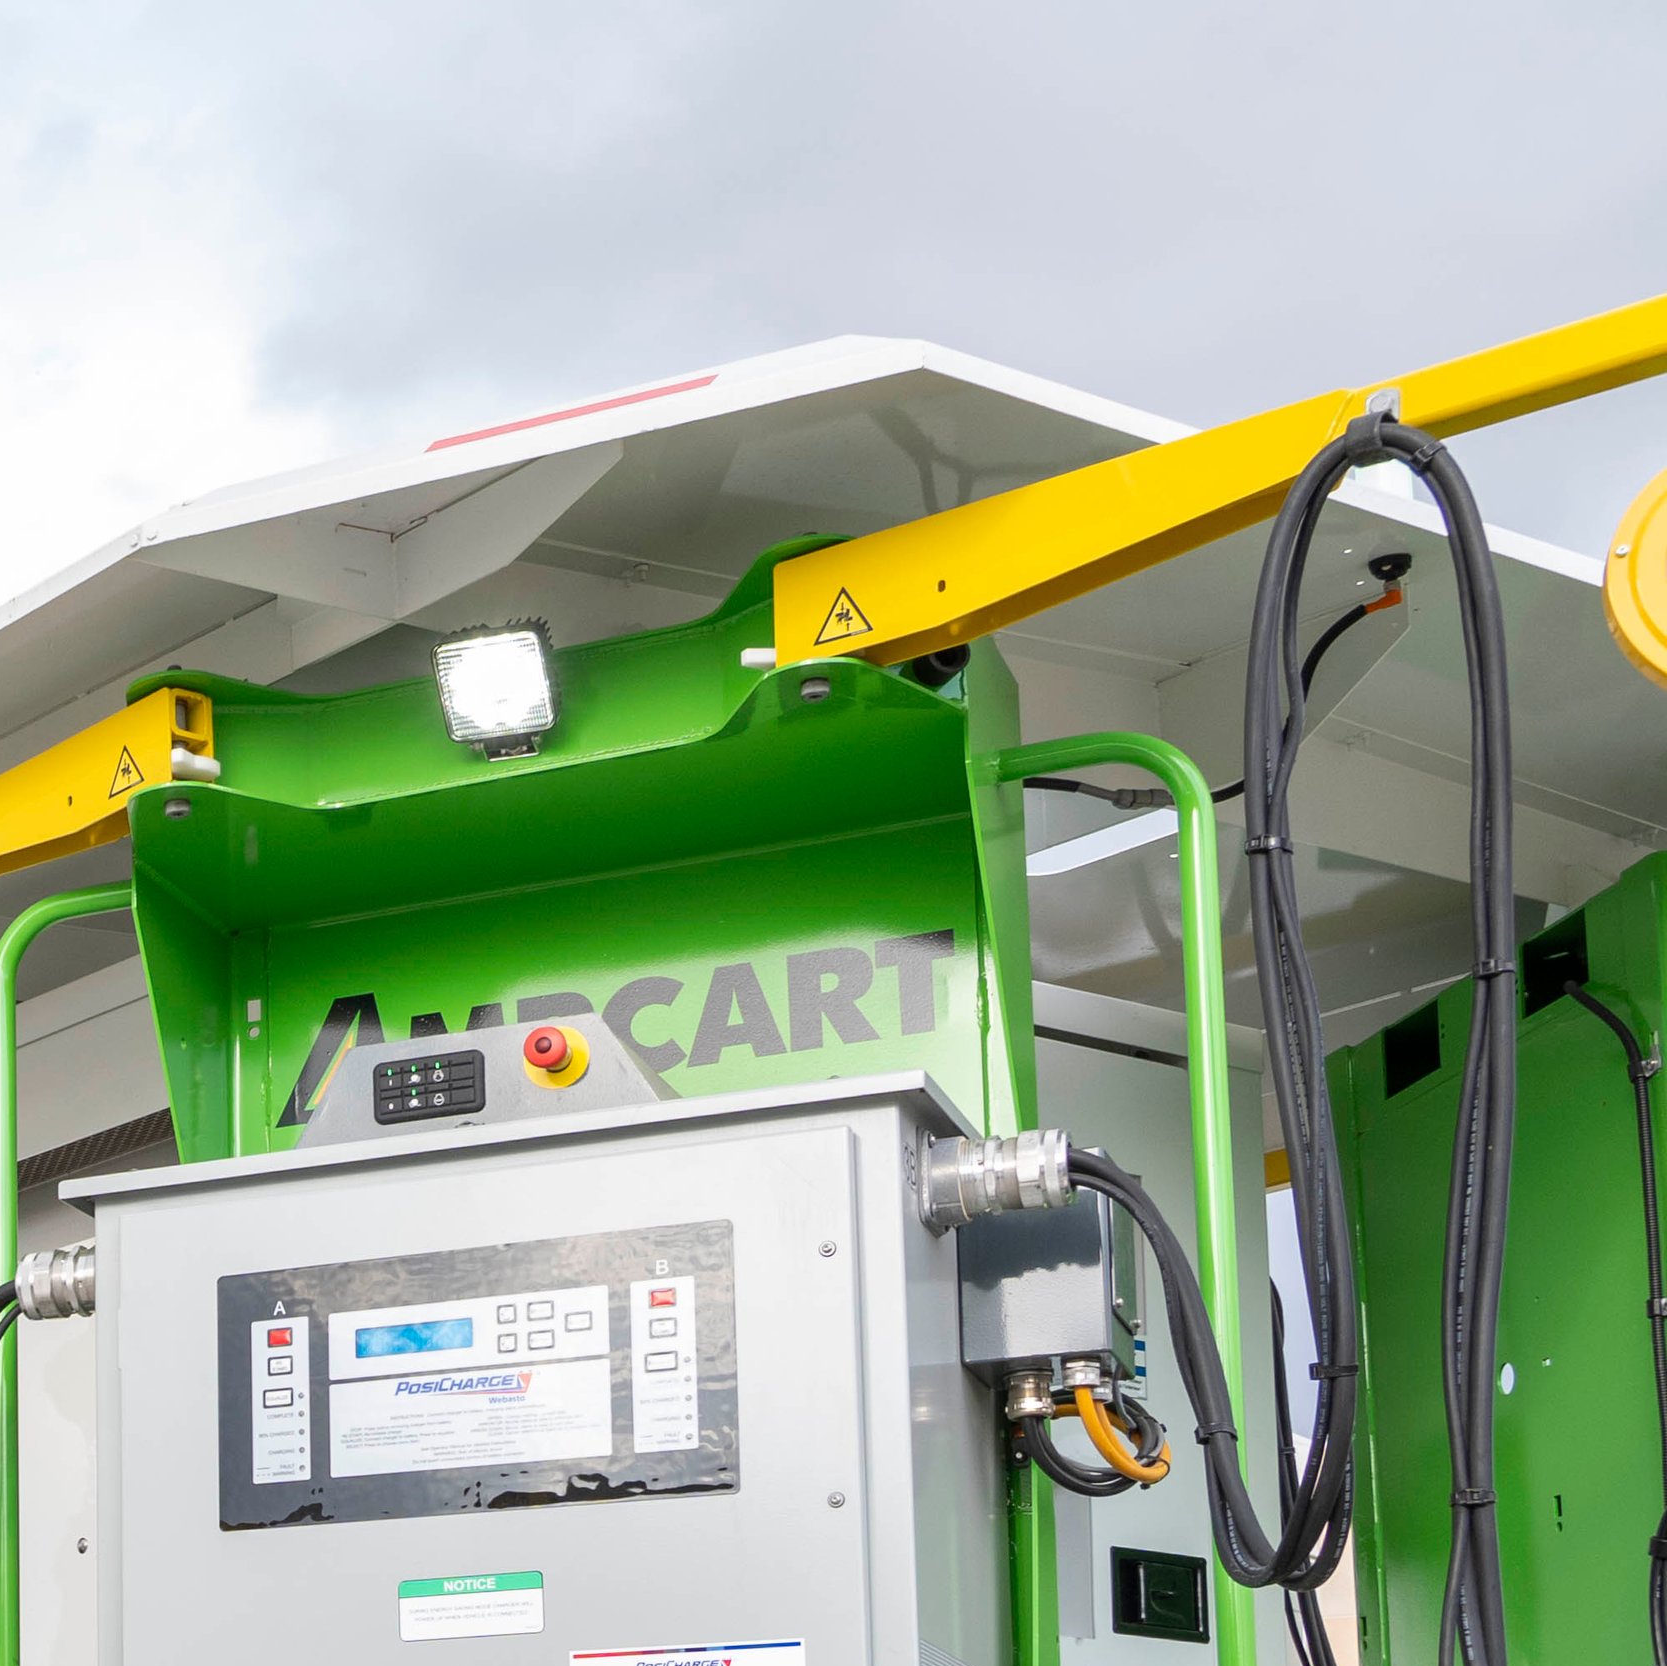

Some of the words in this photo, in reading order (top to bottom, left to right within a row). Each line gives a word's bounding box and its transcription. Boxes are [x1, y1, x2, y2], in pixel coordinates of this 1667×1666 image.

[655, 1260, 669, 1275] B
[273, 1301, 286, 1316] A
[488, 1395, 526, 1404] Webasto
[443, 1577, 497, 1592] NOTICE
